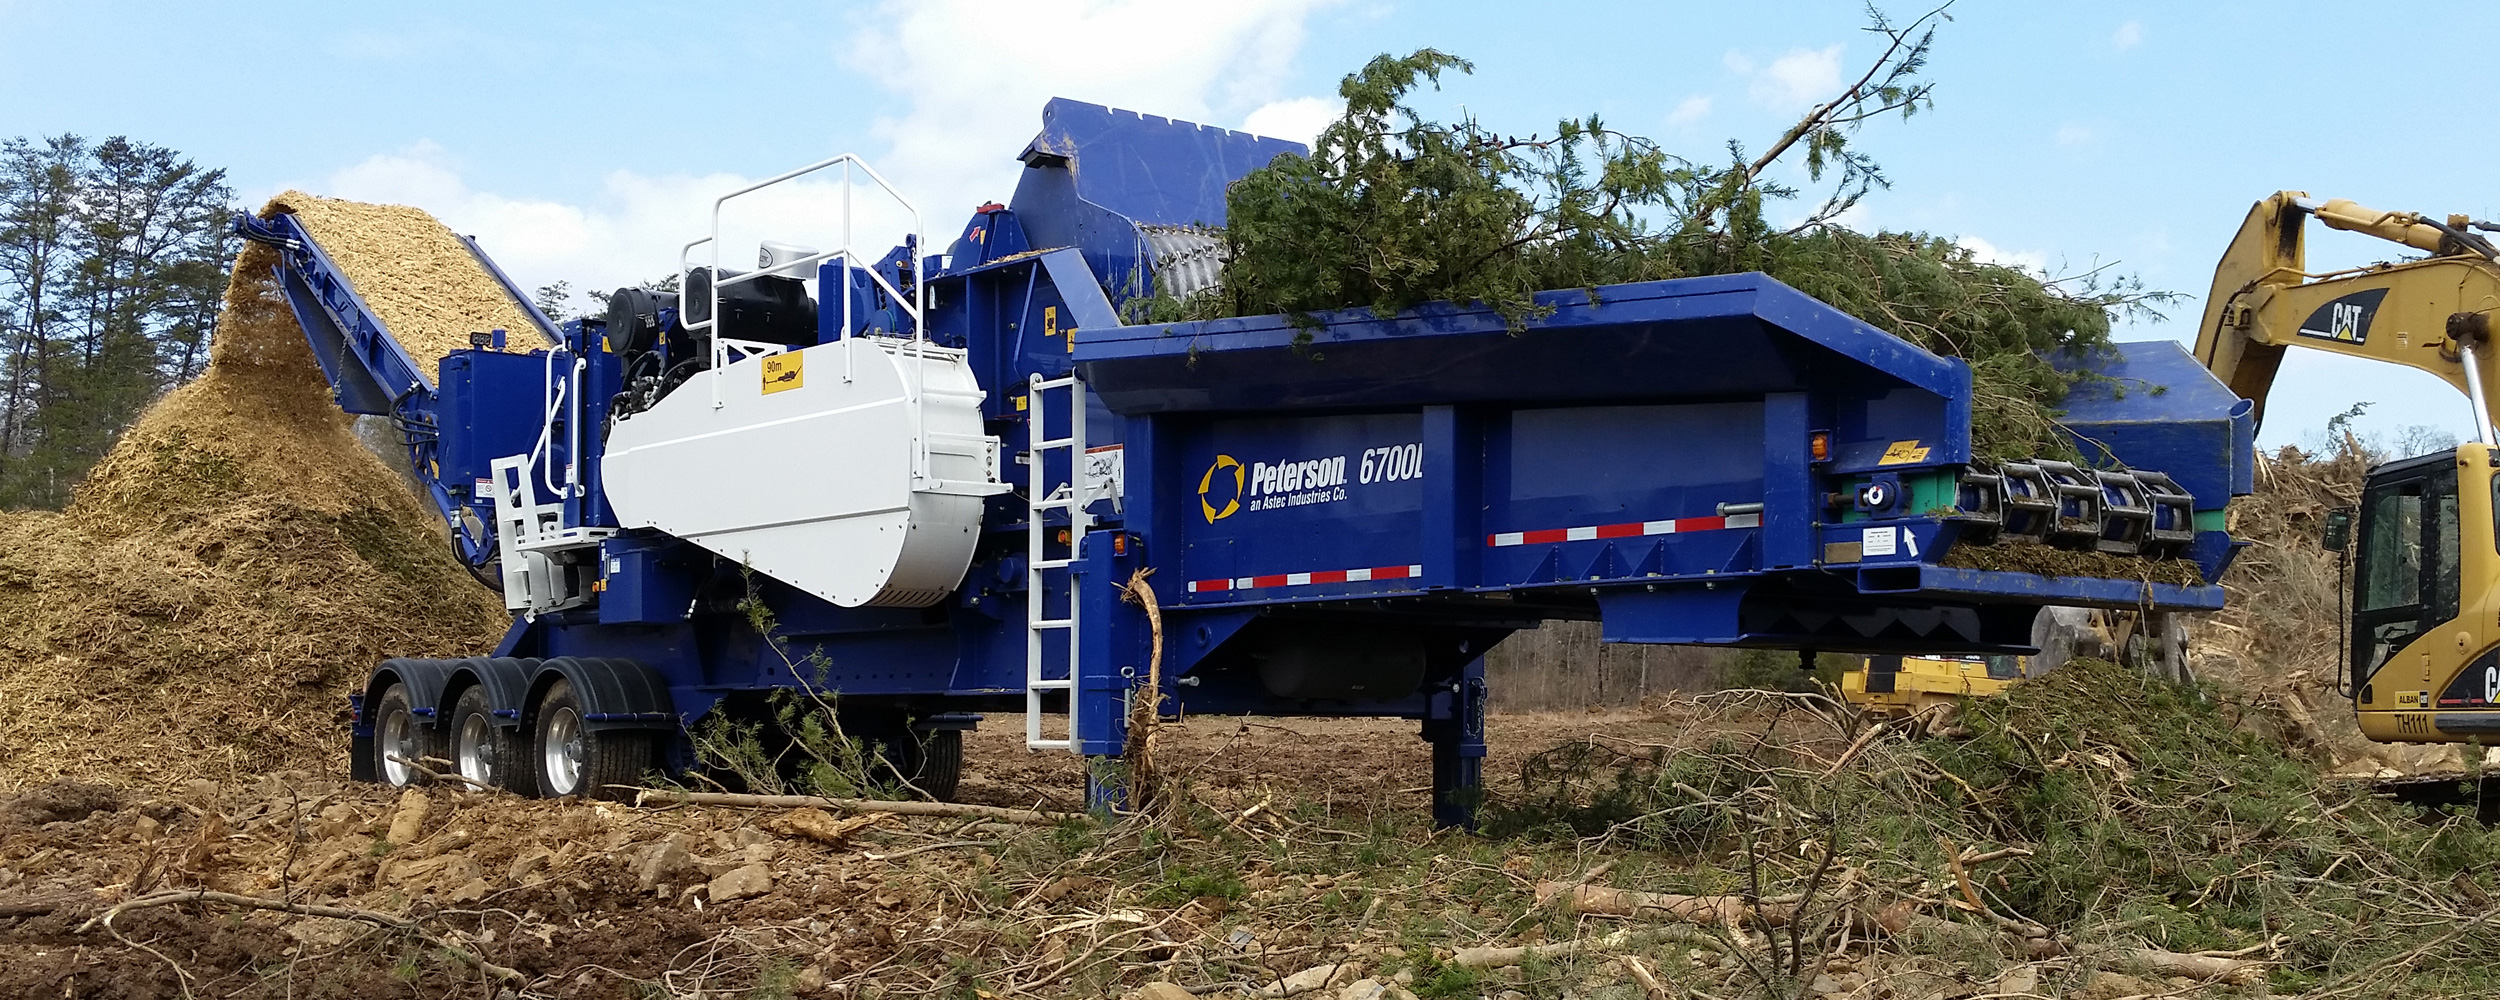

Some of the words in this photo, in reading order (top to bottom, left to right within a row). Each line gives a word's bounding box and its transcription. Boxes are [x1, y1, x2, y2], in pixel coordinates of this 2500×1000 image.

[2331, 302, 2363, 341] CAT
[766, 360, 782, 374] 90m
[1250, 455, 1346, 496] Peterson
[1250, 499, 1261, 511] an
[1262, 496, 1286, 510] Astec
[1287, 489, 1331, 507] Industries
[1333, 486, 1348, 501] Co.
[2399, 695, 2419, 704] ALBAN
[2394, 714, 2429, 734] TH111
